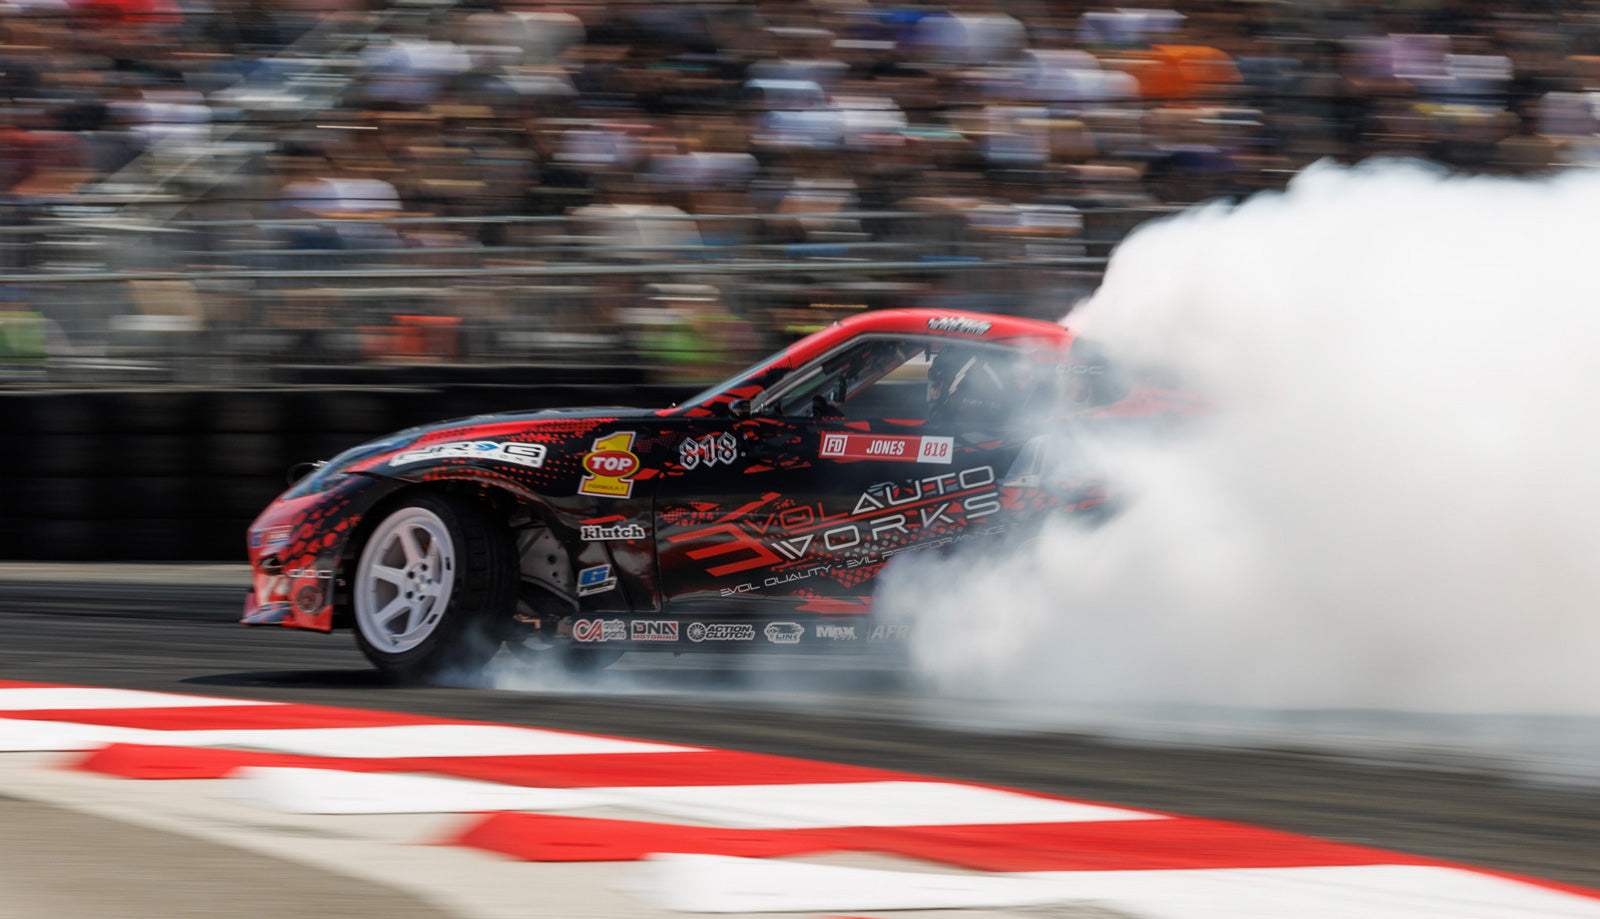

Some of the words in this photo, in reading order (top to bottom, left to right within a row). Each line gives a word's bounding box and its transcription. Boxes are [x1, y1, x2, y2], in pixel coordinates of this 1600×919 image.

[592, 457, 633, 471] TOP
[679, 432, 737, 470] 818
[825, 437, 844, 453] FD
[866, 440, 905, 455] JONES
[923, 442, 948, 457] 818
[852, 466, 995, 515] AUTO
[771, 492, 1000, 560] WORKS
[720, 582, 760, 597] EVOL
[764, 564, 832, 587] QUALITY
[846, 556, 877, 569] EVIL
[633, 622, 677, 634] DNA
